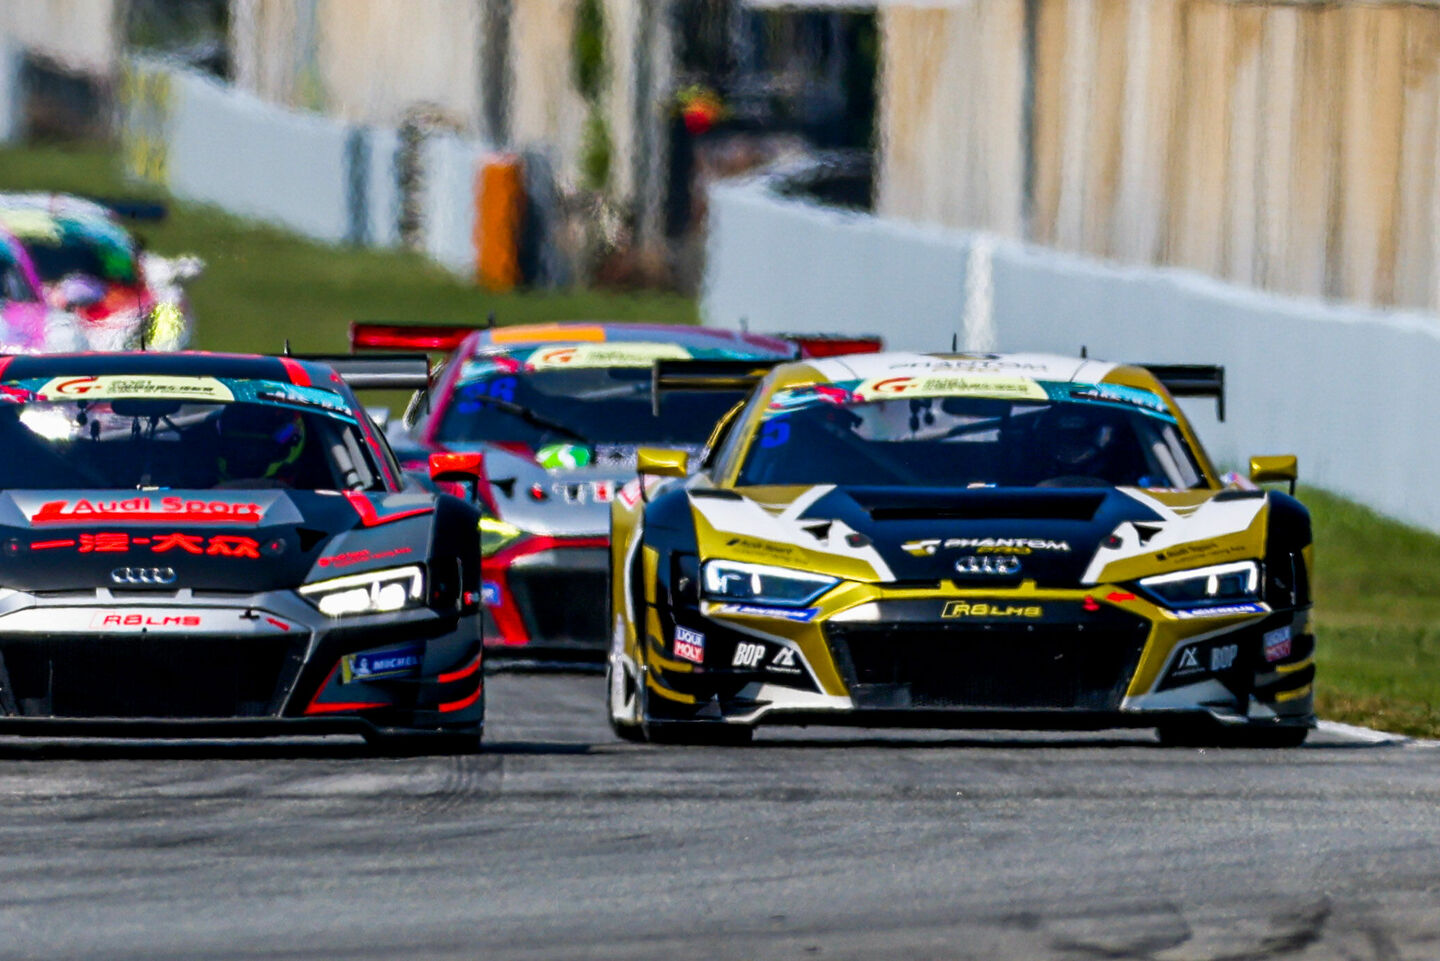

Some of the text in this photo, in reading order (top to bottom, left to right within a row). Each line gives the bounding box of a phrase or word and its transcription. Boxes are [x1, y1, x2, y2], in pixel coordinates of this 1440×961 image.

[72, 496, 264, 518] Audi Sport
[944, 538, 1071, 551] PHANTOM
[732, 642, 767, 667] BOP
